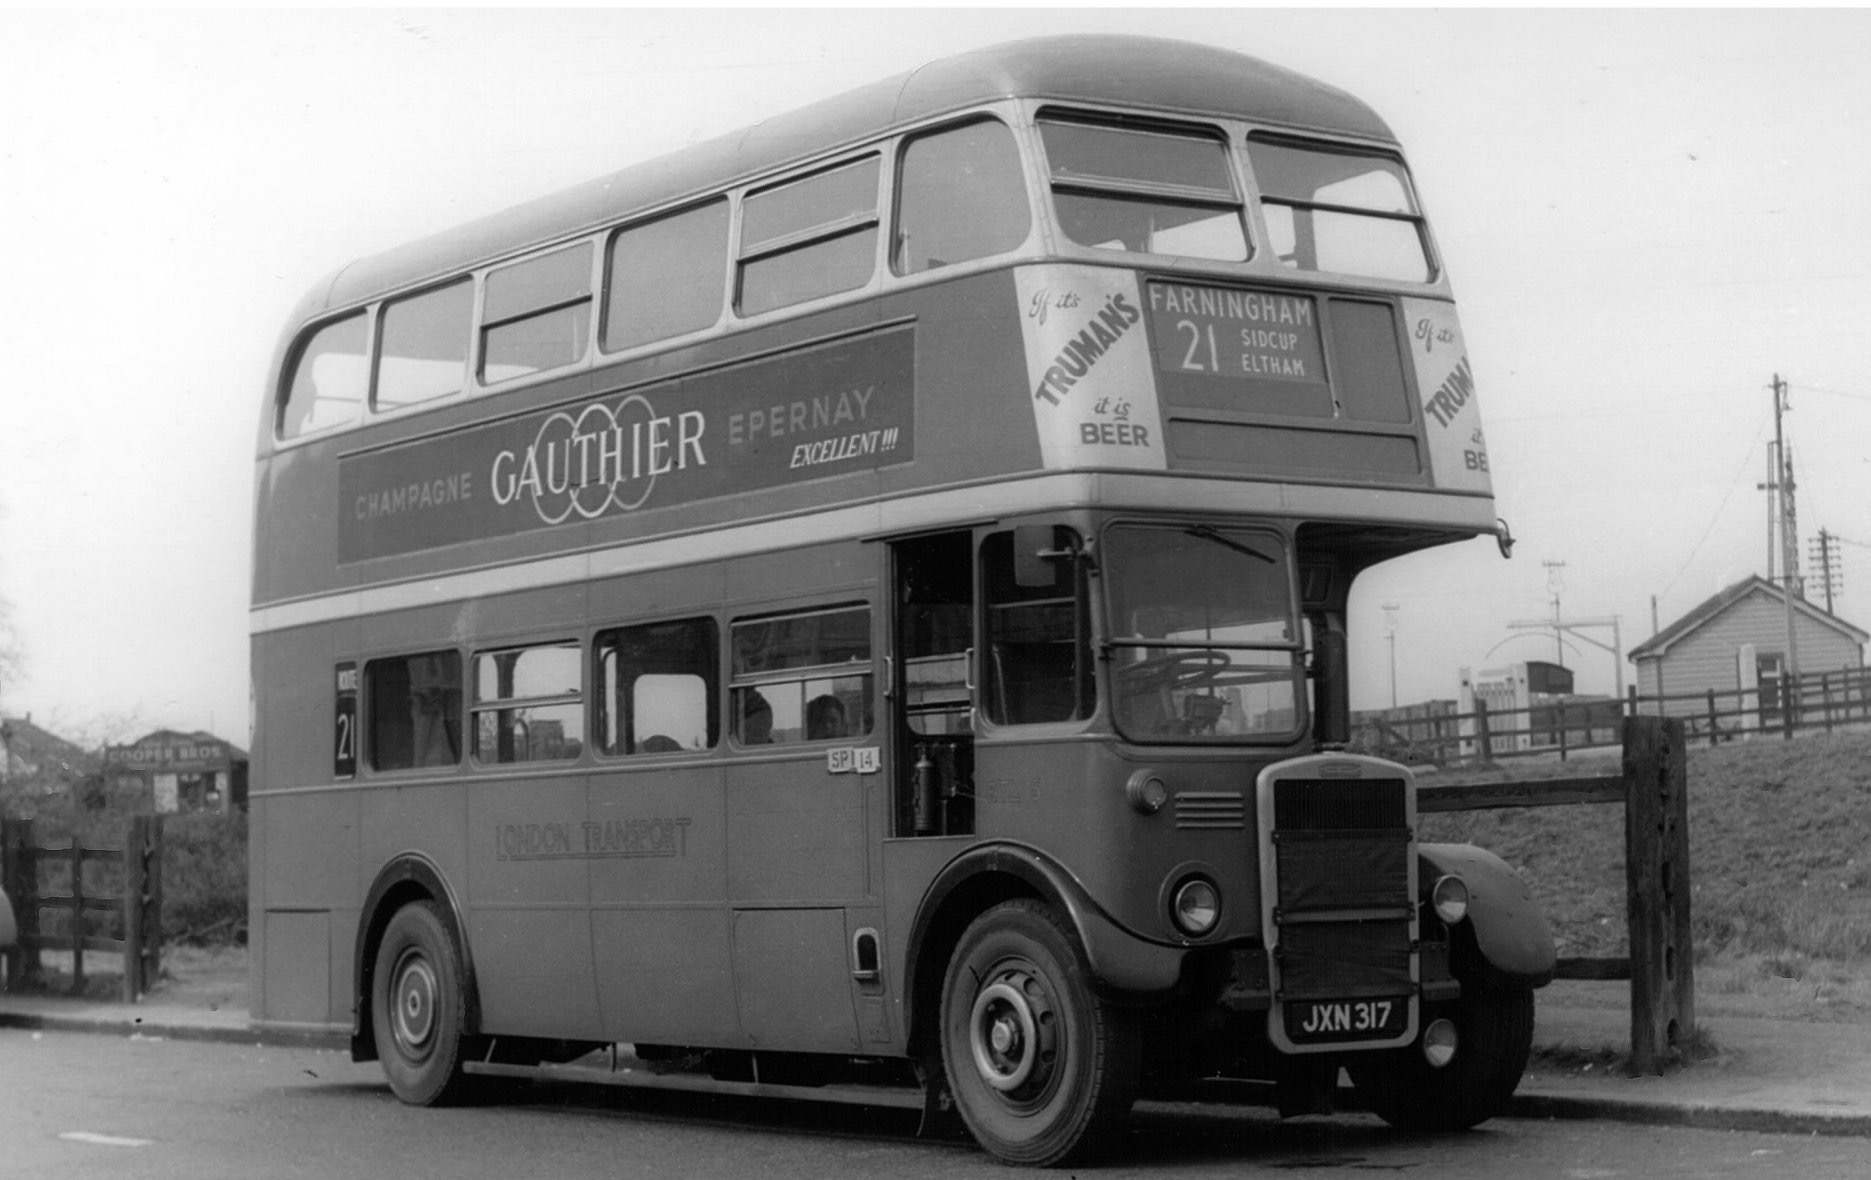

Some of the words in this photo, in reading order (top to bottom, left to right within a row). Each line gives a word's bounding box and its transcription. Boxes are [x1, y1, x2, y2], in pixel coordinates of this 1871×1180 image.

[1029, 287, 1051, 326] If
[1150, 282, 1313, 327] FARNINGHAM
[1034, 292, 1141, 407] TRUMAN'S
[1176, 319, 1220, 372] 21
[1240, 328, 1298, 351] SIDCUP
[1415, 318, 1434, 352] If
[1241, 353, 1306, 377] ELTHAM
[1094, 396, 1111, 415] it
[1114, 397, 1132, 418] is
[1079, 422, 1150, 448] BEER
[355, 471, 474, 521] CHAMPAGNE
[490, 409, 708, 506] GAUTHIER
[727, 386, 876, 446] EPERNAY
[337, 713, 355, 760] 21
[108, 748, 173, 763] COOPER
[831, 750, 849, 769] SP
[860, 751, 873, 769] 14
[495, 822, 571, 862] LONDON
[581, 817, 693, 858] TRANSPORT
[1302, 1003, 1351, 1032] JXN
[1354, 1001, 1393, 1031] 317
